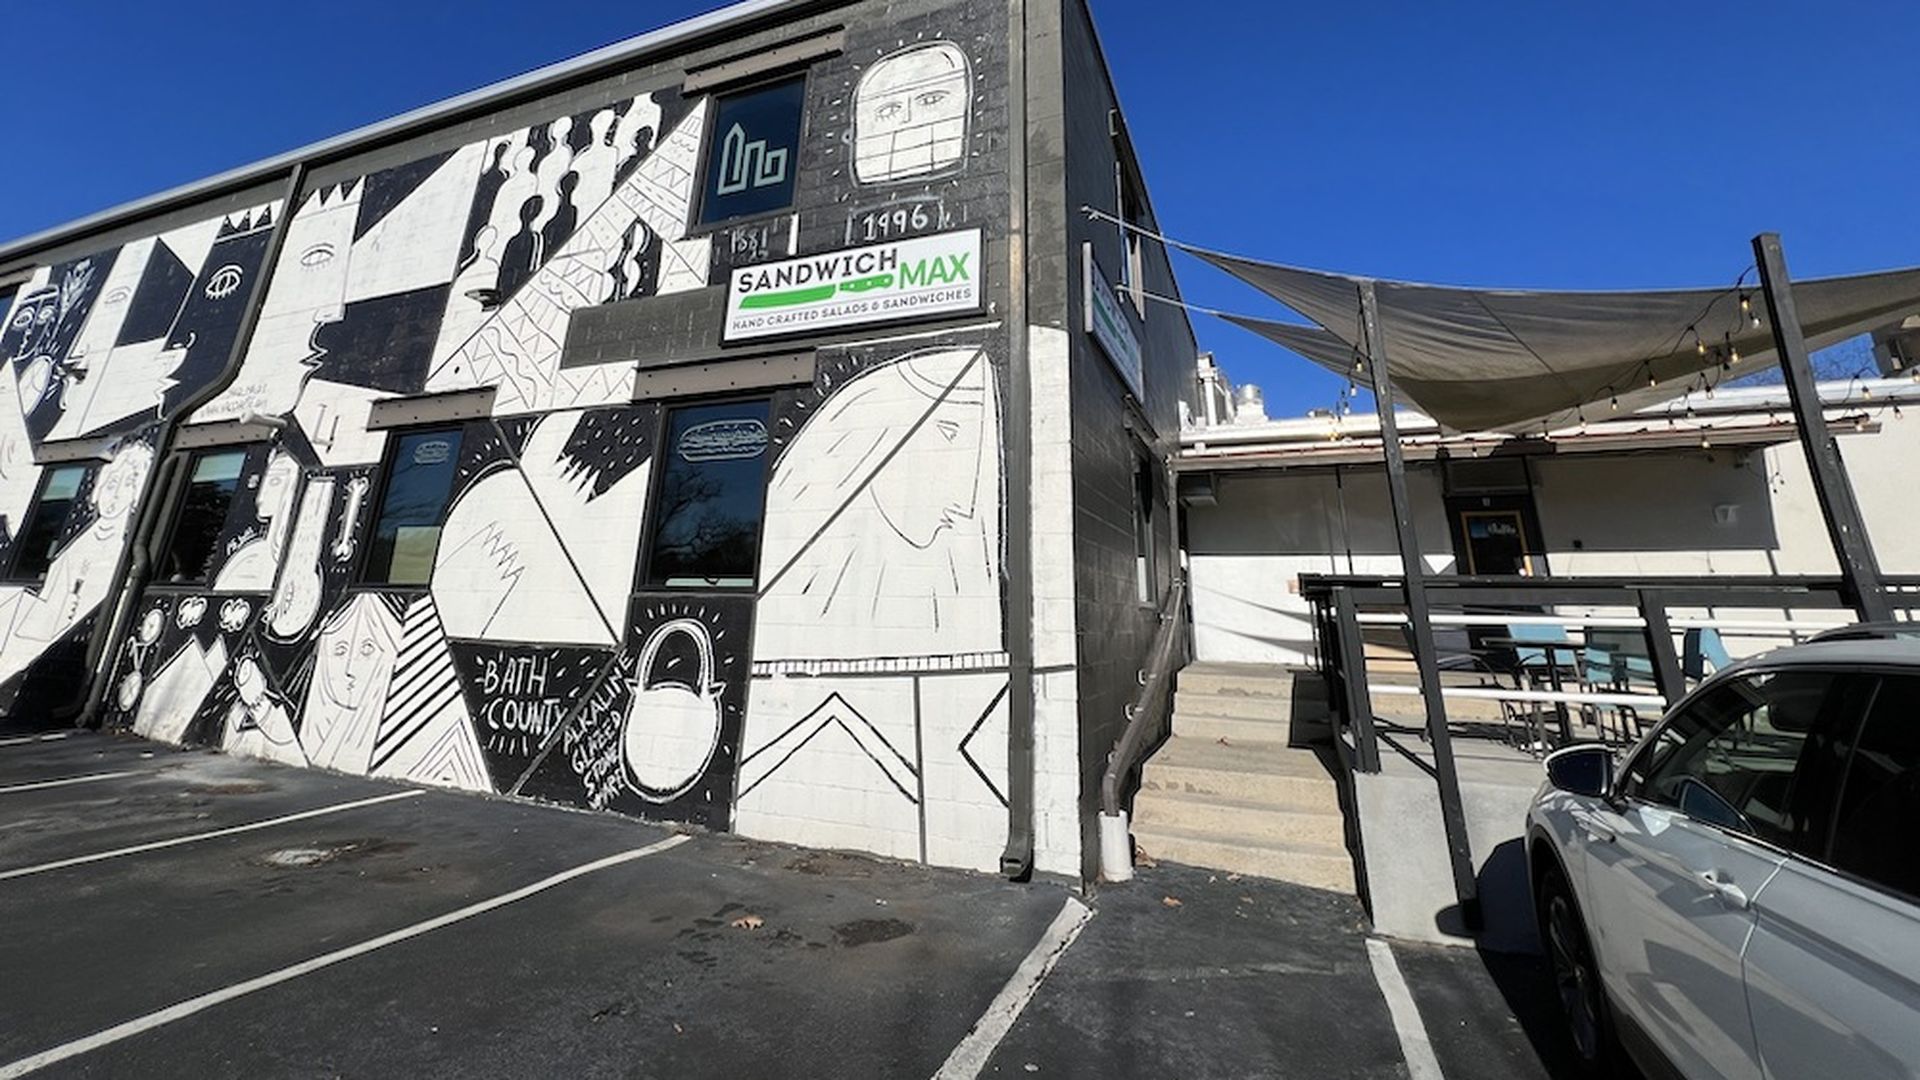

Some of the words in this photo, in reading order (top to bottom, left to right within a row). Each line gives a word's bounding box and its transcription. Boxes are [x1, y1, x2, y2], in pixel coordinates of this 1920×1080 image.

[863, 203, 929, 241] 1996
[738, 248, 898, 294] SANDWICH
[899, 252, 970, 290] MAX
[732, 317, 765, 331] HAND
[767, 310, 819, 327] CRAFTED
[821, 301, 869, 319] SALADS
[884, 287, 973, 310] SANDWICHES
[484, 655, 548, 697] BATH
[486, 698, 568, 751] COUNTY
[563, 648, 635, 755] ALKALINE
[571, 710, 622, 775] GLAZED
